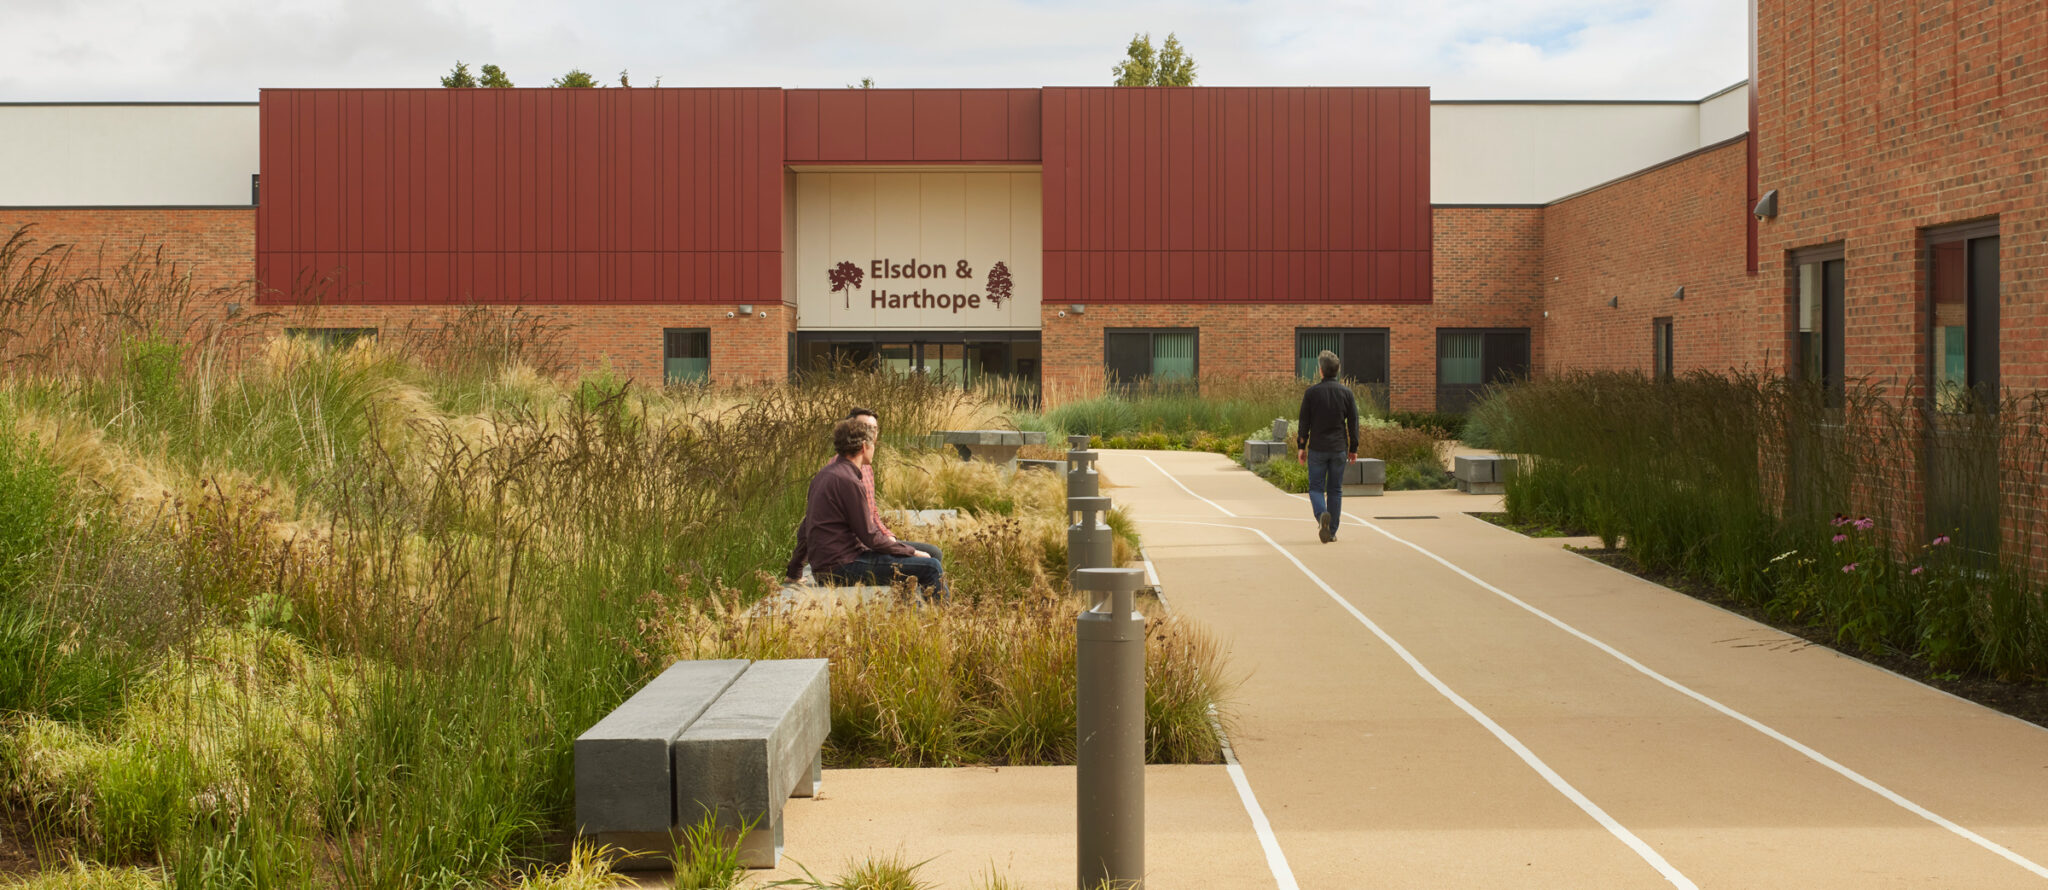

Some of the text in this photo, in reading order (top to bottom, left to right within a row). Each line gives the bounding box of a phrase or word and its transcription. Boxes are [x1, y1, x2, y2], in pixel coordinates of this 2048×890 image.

[870, 258, 973, 280] Elsdon &
[870, 289, 981, 314] Harthope
